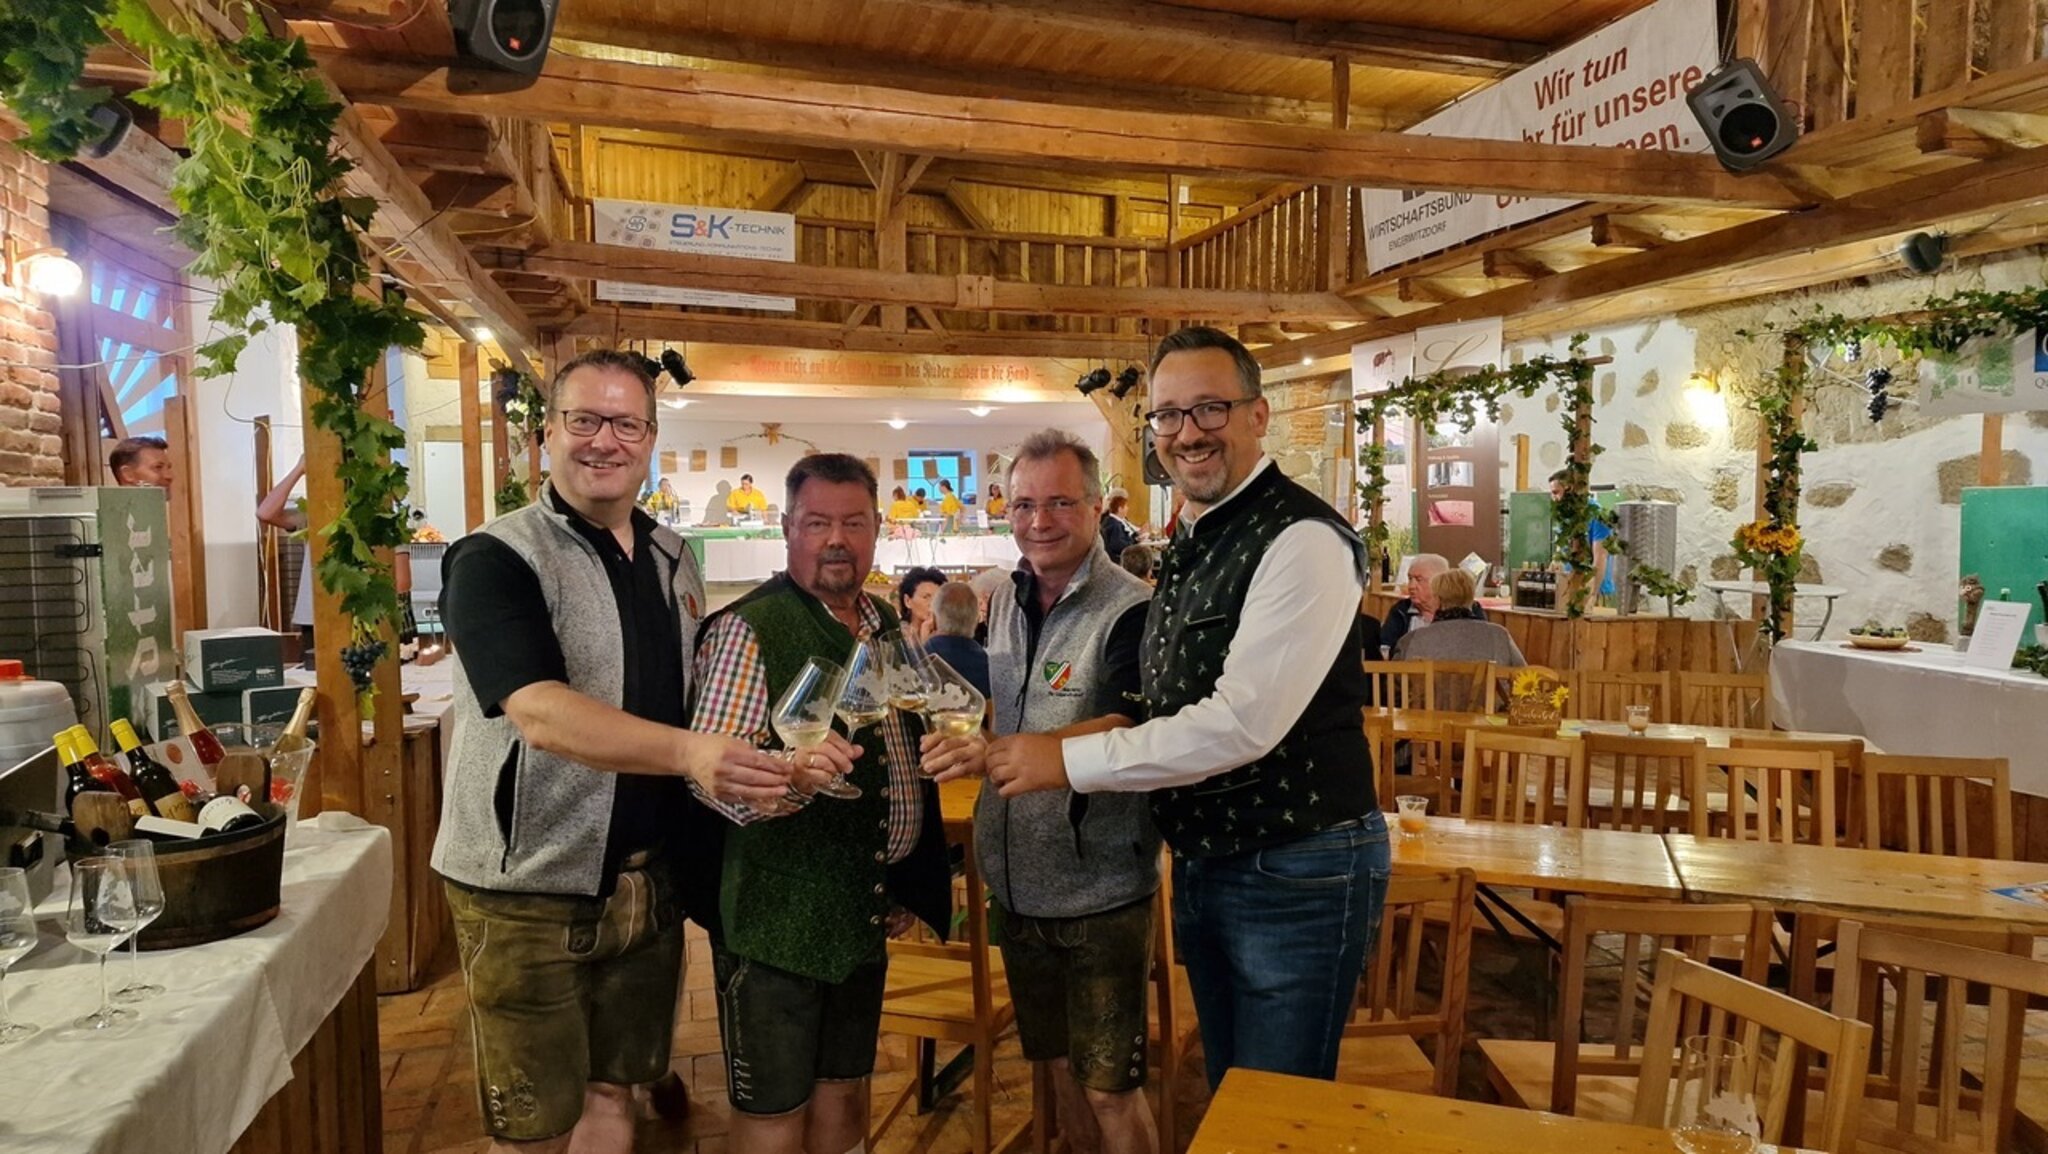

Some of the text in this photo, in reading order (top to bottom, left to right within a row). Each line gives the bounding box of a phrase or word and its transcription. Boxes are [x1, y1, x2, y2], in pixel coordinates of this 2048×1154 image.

[1534, 46, 1628, 110] Wir tun
[1551, 108, 1586, 145] für
[1594, 64, 1703, 128] unsere
[1368, 191, 1473, 240] WIRTSCHAFTSBUND
